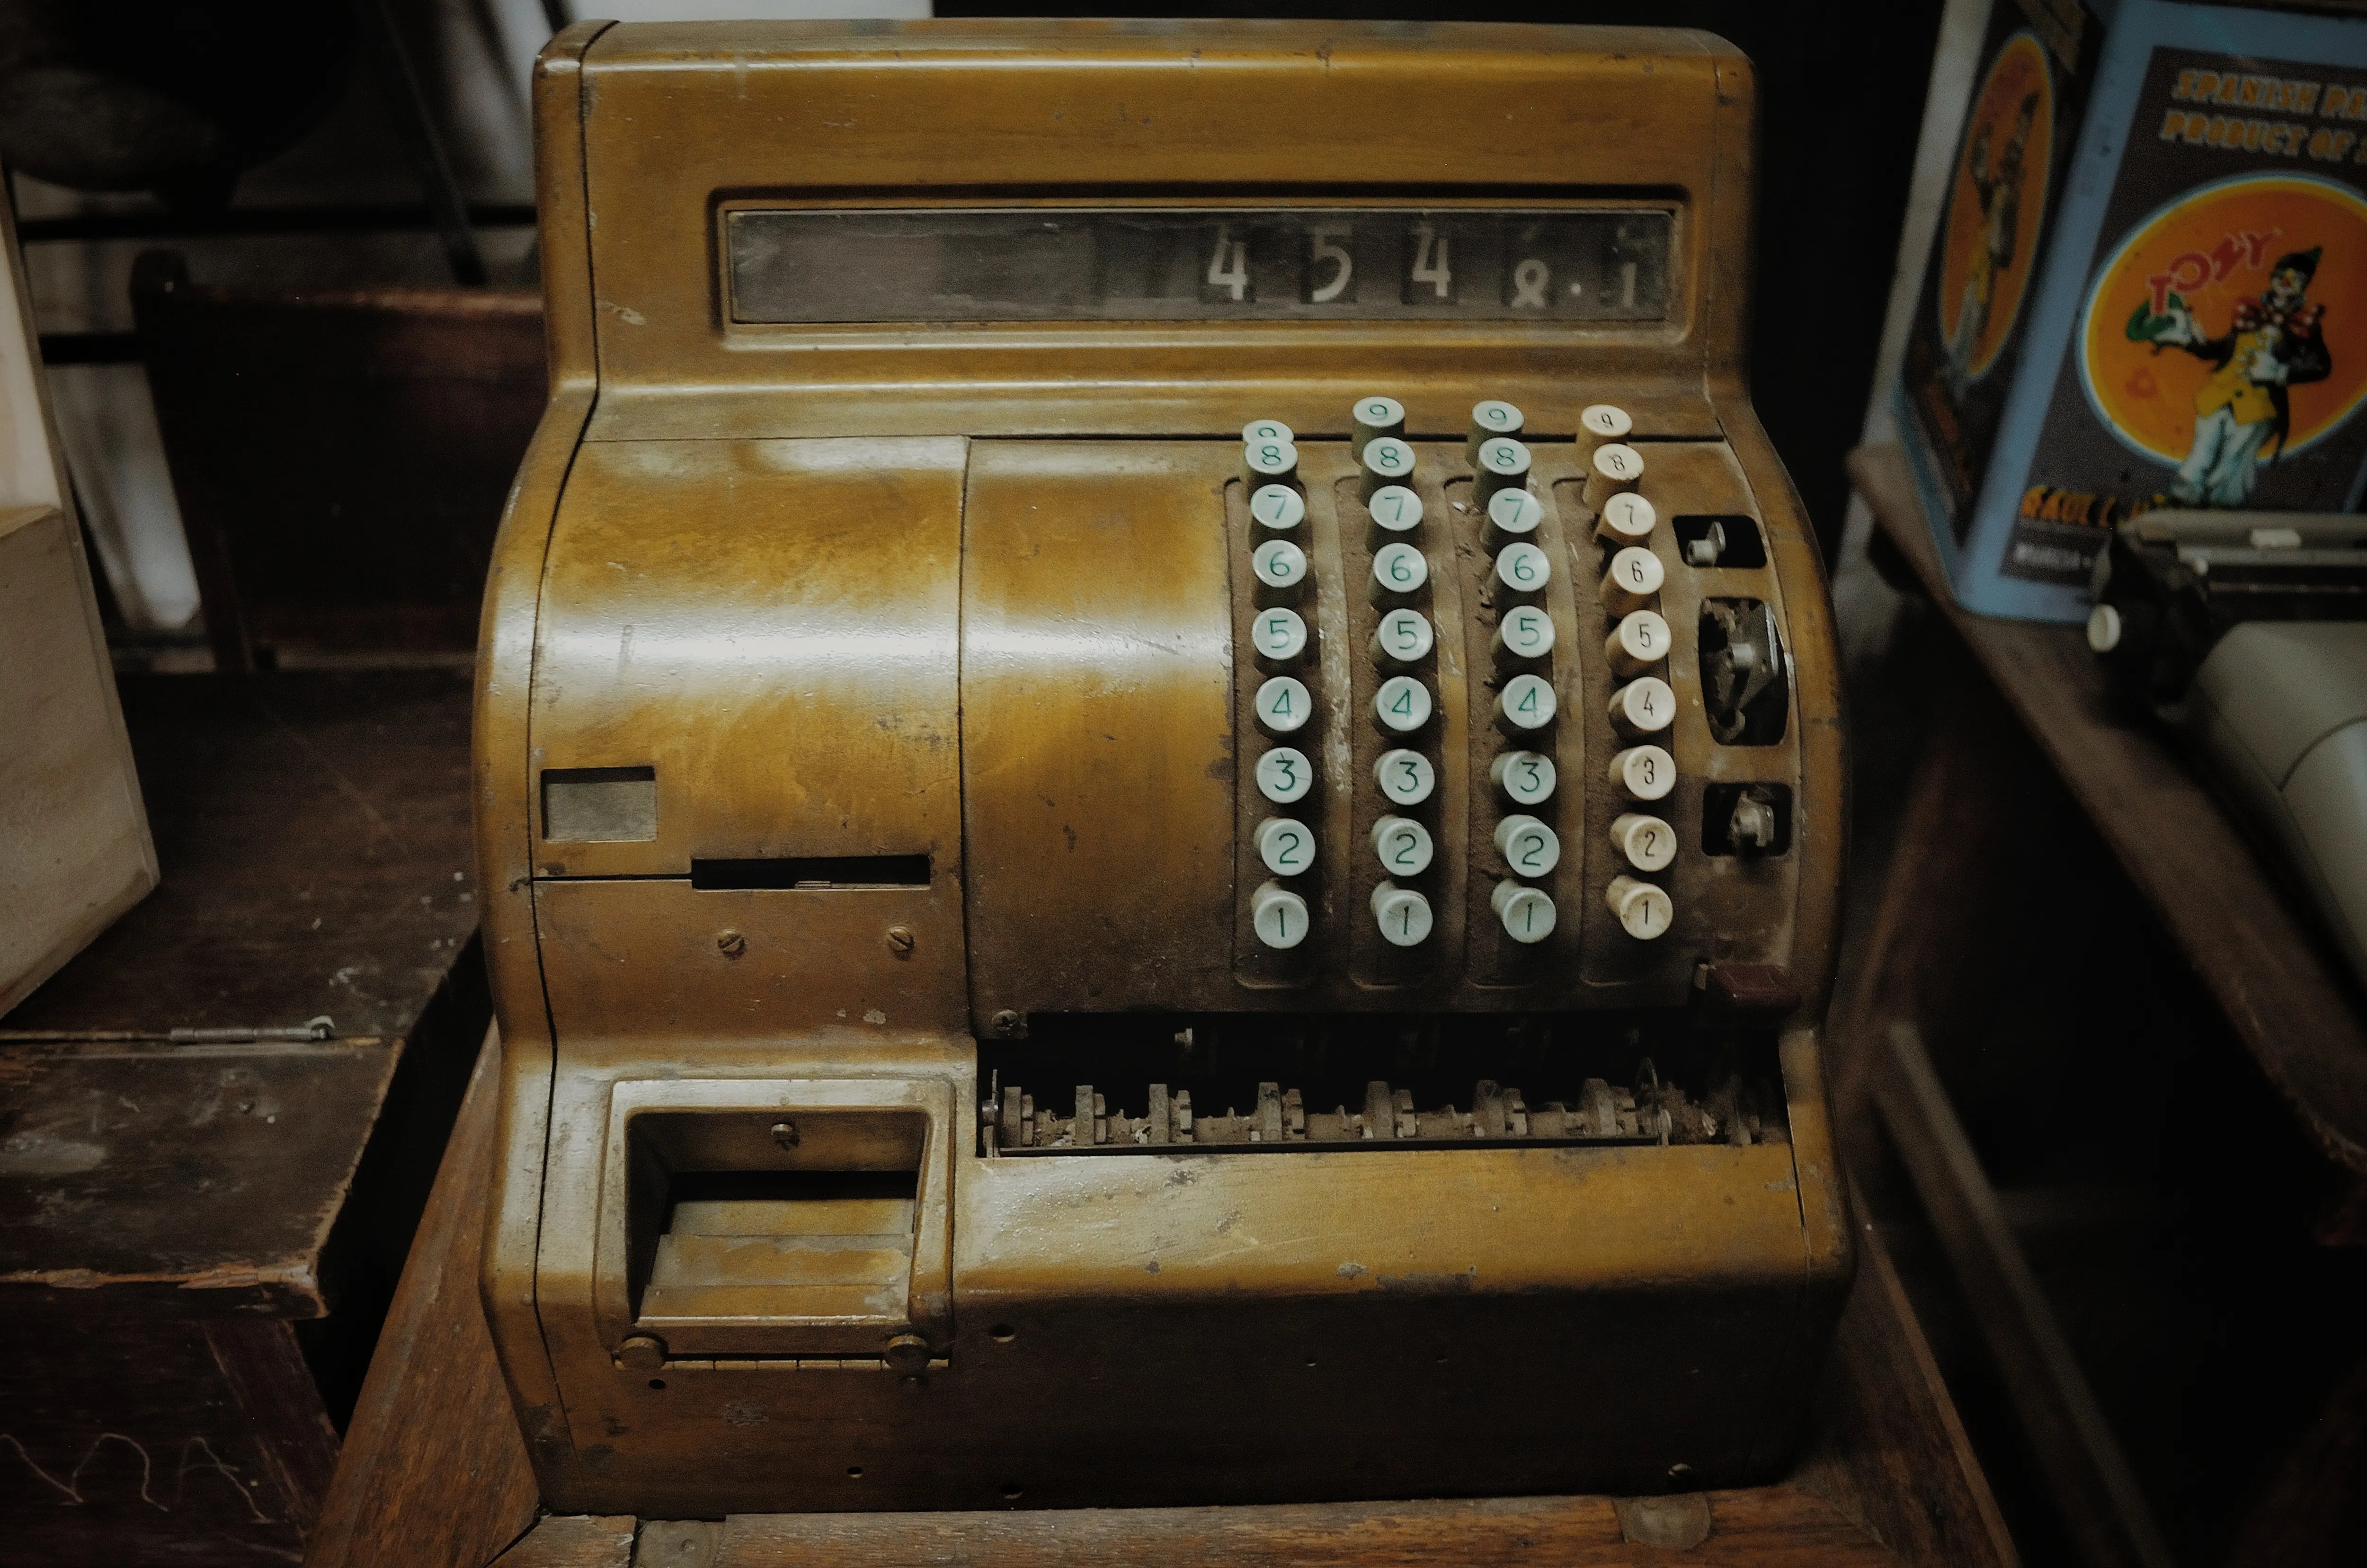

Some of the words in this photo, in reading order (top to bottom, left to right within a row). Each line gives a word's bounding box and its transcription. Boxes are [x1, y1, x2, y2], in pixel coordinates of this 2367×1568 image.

[2172, 69, 2321, 114] SPANISH
[2321, 84, 2367, 121] PA
[2159, 108, 2309, 157] PRODUCT
[2308, 127, 2356, 162] OF
[2145, 228, 2279, 317] TONY
[1369, 404, 1388, 419] 9
[1488, 409, 1507, 422] 9
[1601, 414, 1613, 427] 9
[1262, 445, 1281, 465] 8
[1380, 447, 1400, 468] 8
[1496, 447, 1515, 466] 8
[1610, 454, 1626, 471] 8
[1267, 494, 1285, 519] 7
[1384, 496, 1402, 521] 7
[1504, 497, 1523, 523] 7
[1625, 504, 1634, 525] 7
[1269, 552, 1290, 577] 6
[1391, 555, 1411, 582] 6
[1514, 554, 1534, 581] 6
[1631, 561, 1643, 582] 6
[1269, 619, 1290, 649] 5
[1397, 620, 1416, 650] 5
[1520, 617, 1540, 646] 5
[1639, 624, 1651, 647] 5
[1272, 688, 1291, 717] 4
[1391, 688, 1411, 717] 4
[1518, 687, 1537, 716] 4
[1644, 691, 1653, 715] 4
[1274, 759, 1296, 792] 3
[1397, 761, 1418, 793] 3
[1520, 761, 1540, 792] 3
[1644, 757, 1654, 784] 3
[1278, 832, 1299, 864] 2
[1395, 833, 1416, 864] 2
[1522, 835, 1545, 866] 2
[1645, 831, 1656, 857] 2
